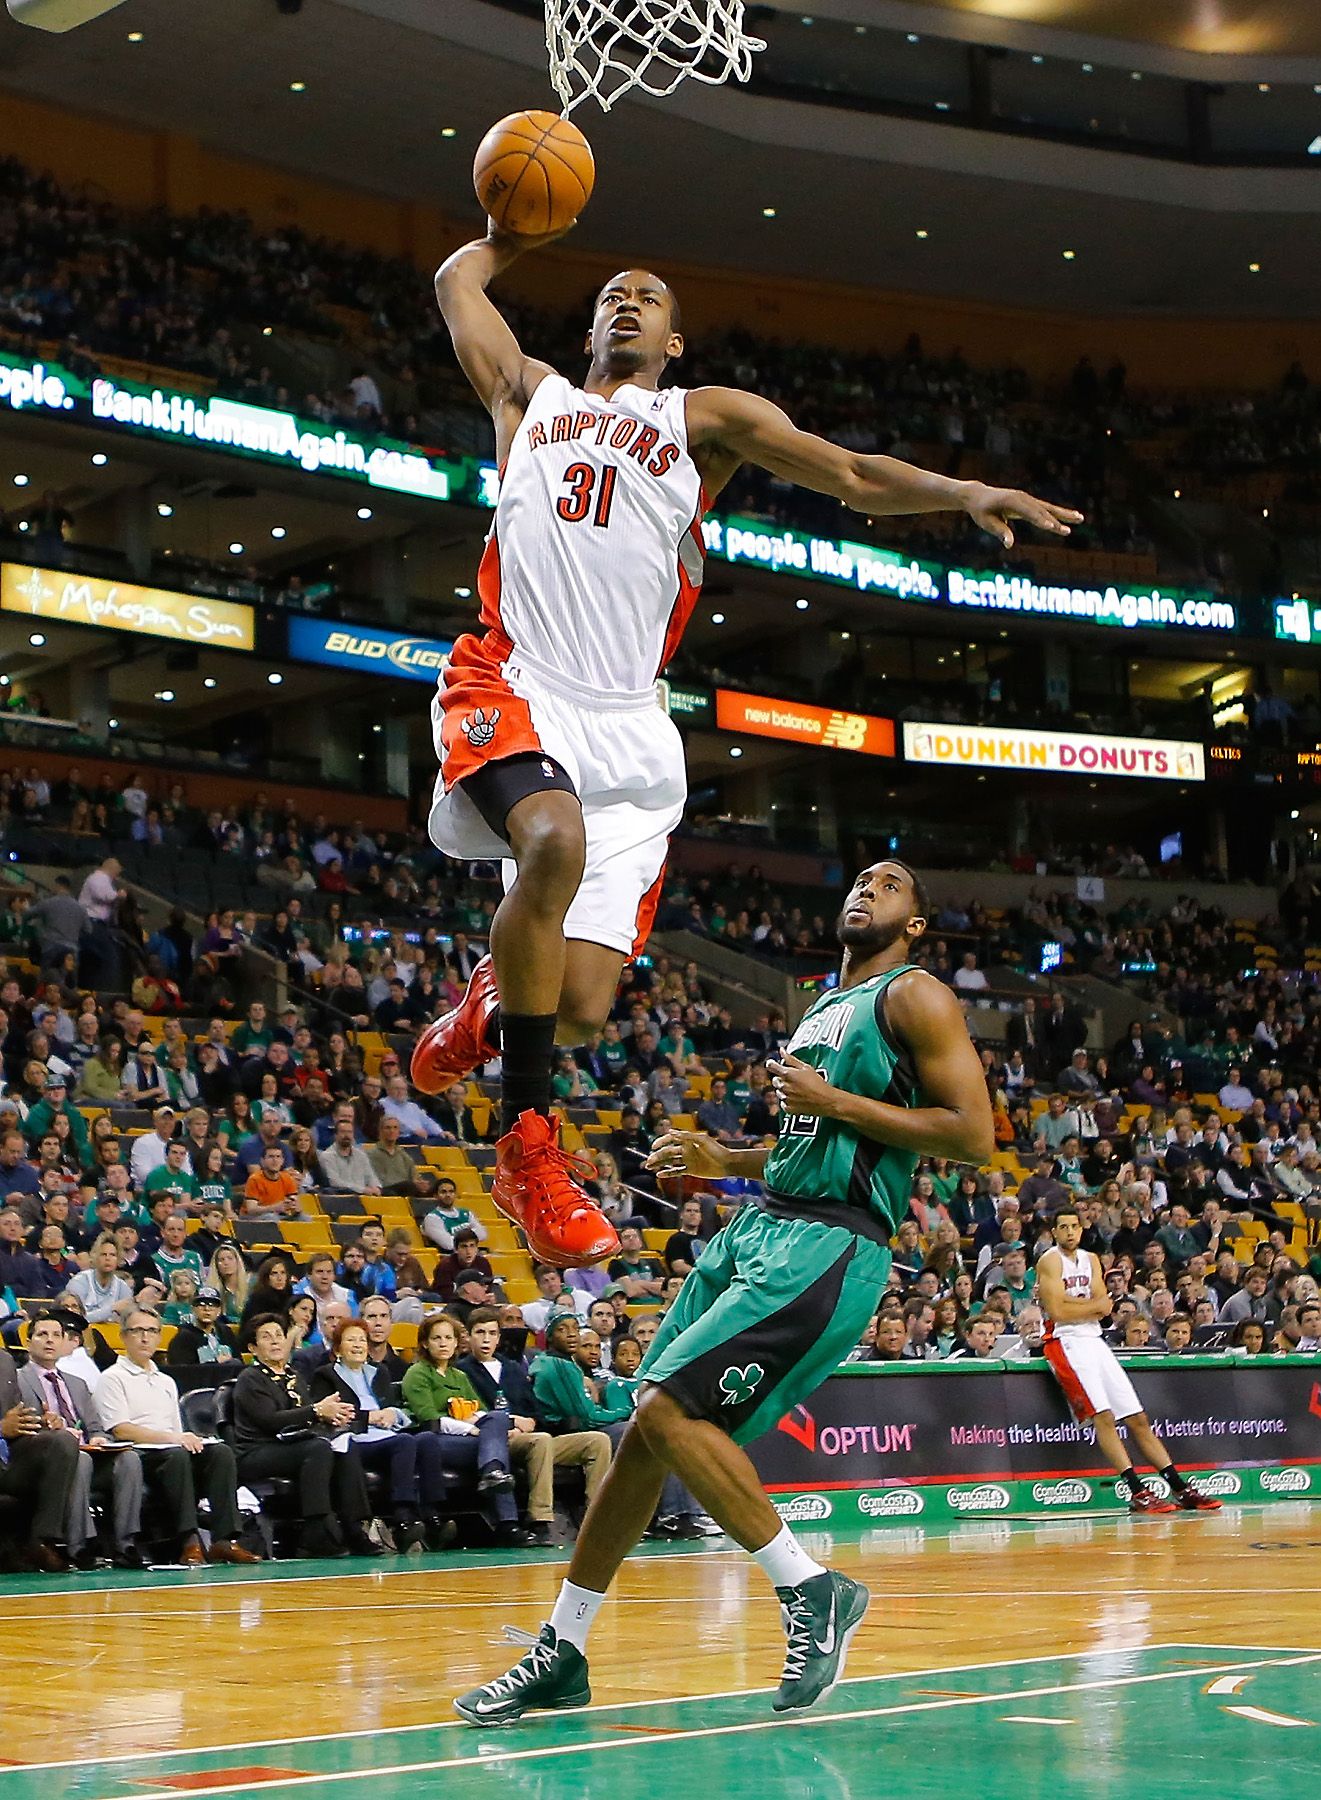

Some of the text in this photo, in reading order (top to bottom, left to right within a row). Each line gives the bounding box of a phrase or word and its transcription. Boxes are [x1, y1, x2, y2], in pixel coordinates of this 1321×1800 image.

[527, 410, 680, 477] RAPTORS
[557, 462, 618, 528] 31
[726, 527, 807, 571] people
[810, 538, 853, 580] like
[857, 557, 940, 600] people.
[59, 581, 243, 639] Mohegan Sun
[947, 570, 1235, 629] BankHumanAgain.com
[324, 632, 387, 659] BUD
[671, 692, 707, 705] MEXICAN
[744, 708, 770, 724] new
[772, 710, 821, 734] balance
[934, 735, 1169, 774] DUNKIN' DONUTS
[1210, 746, 1241, 759] CELTICS
[950, 1424, 1007, 1447] Making
[1008, 1424, 1033, 1444] the
[1035, 1422, 1080, 1443] health
[1165, 1418, 1205, 1438] better
[1206, 1416, 1227, 1435] for
[1228, 1417, 1287, 1438] everyone.
